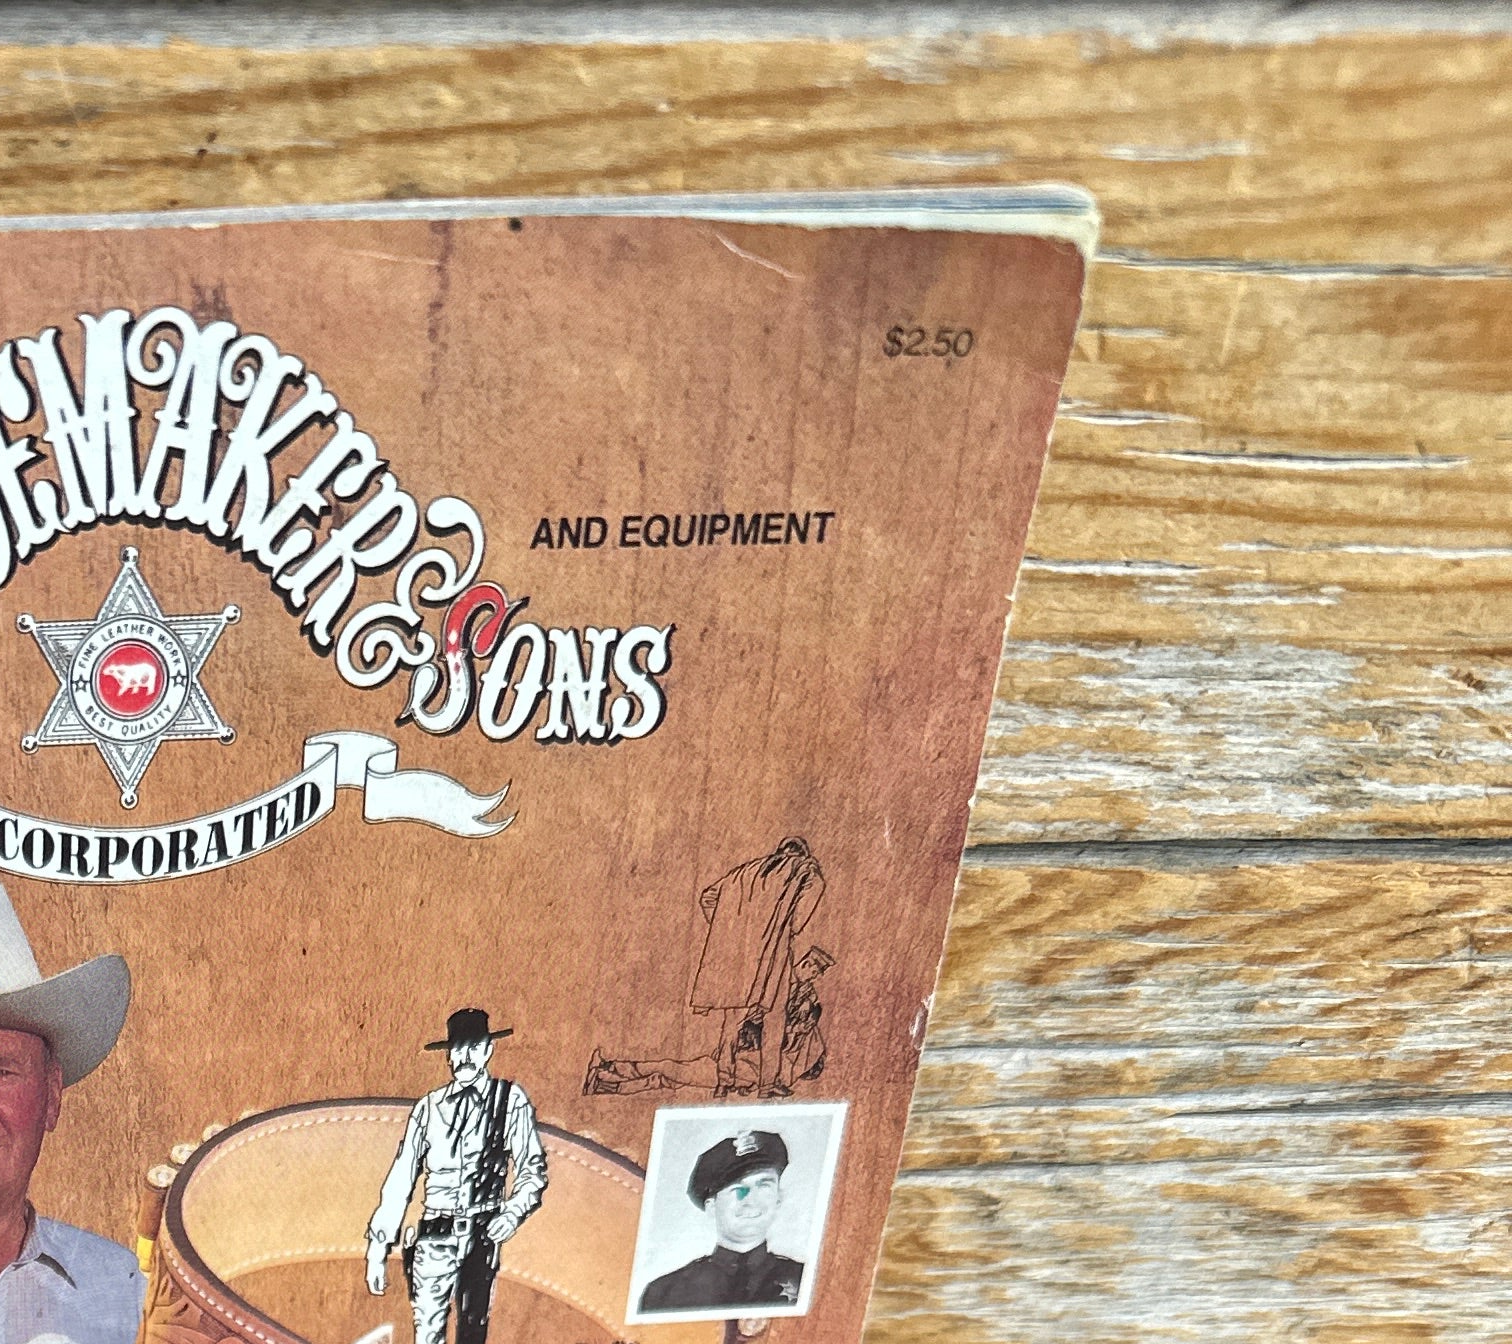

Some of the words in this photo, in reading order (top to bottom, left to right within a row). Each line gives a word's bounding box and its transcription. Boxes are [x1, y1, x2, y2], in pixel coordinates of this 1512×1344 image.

[882, 325, 974, 358] $2.50
[531, 515, 608, 550] AND
[619, 510, 836, 547] EQUIPMENT
[78, 642, 98, 669] FINE
[102, 623, 154, 642] LEATHER
[158, 634, 181, 667] WORK
[395, 578, 678, 747] SONS
[84, 705, 114, 732] BEST
[121, 704, 173, 737] QUALITY
